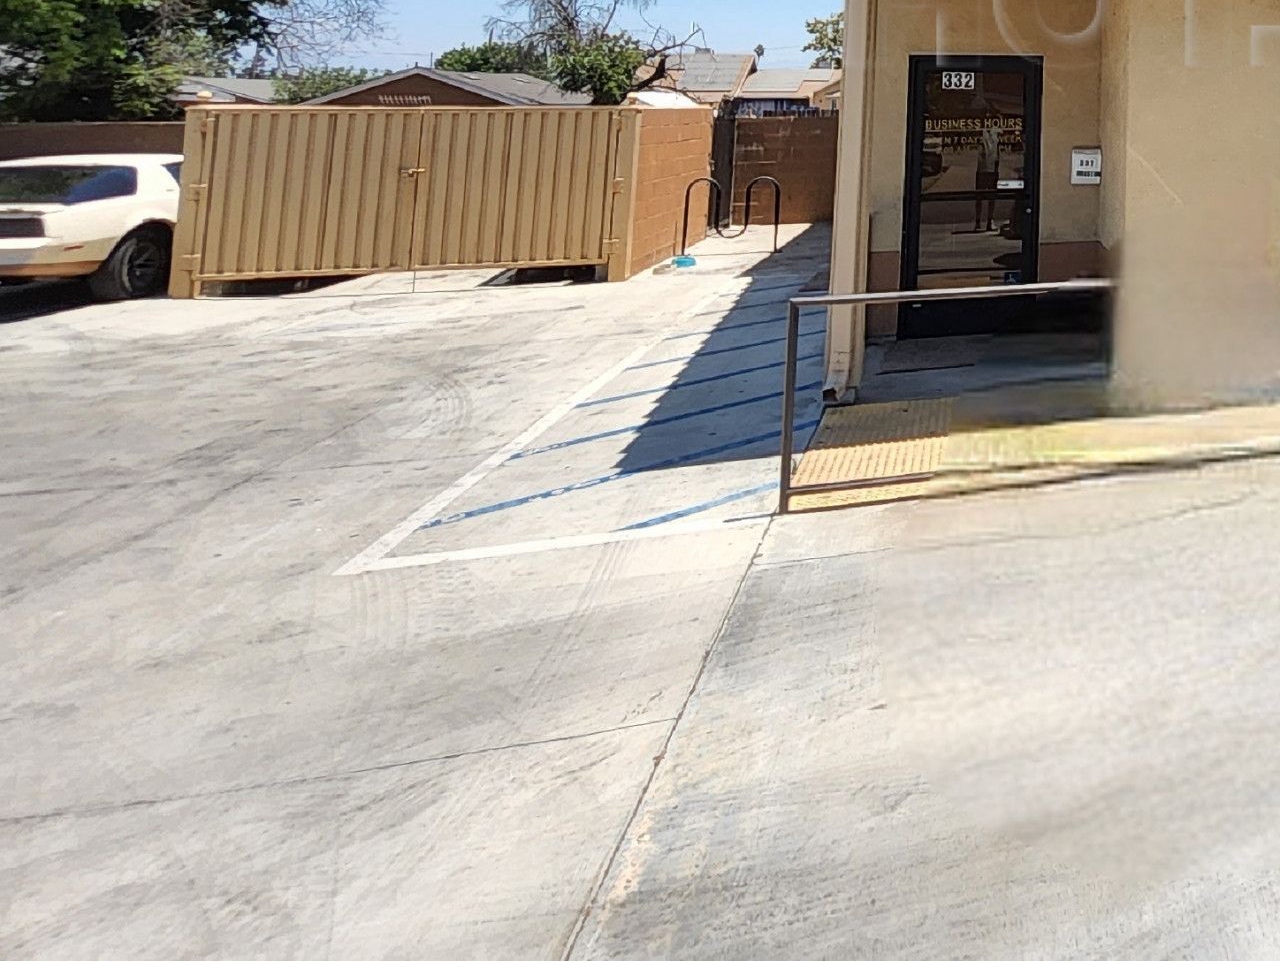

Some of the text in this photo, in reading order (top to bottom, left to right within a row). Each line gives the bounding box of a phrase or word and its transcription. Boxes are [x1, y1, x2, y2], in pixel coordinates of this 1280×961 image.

[943, 72, 973, 88] 332
[925, 117, 1023, 130] BUSINESS HOURS
